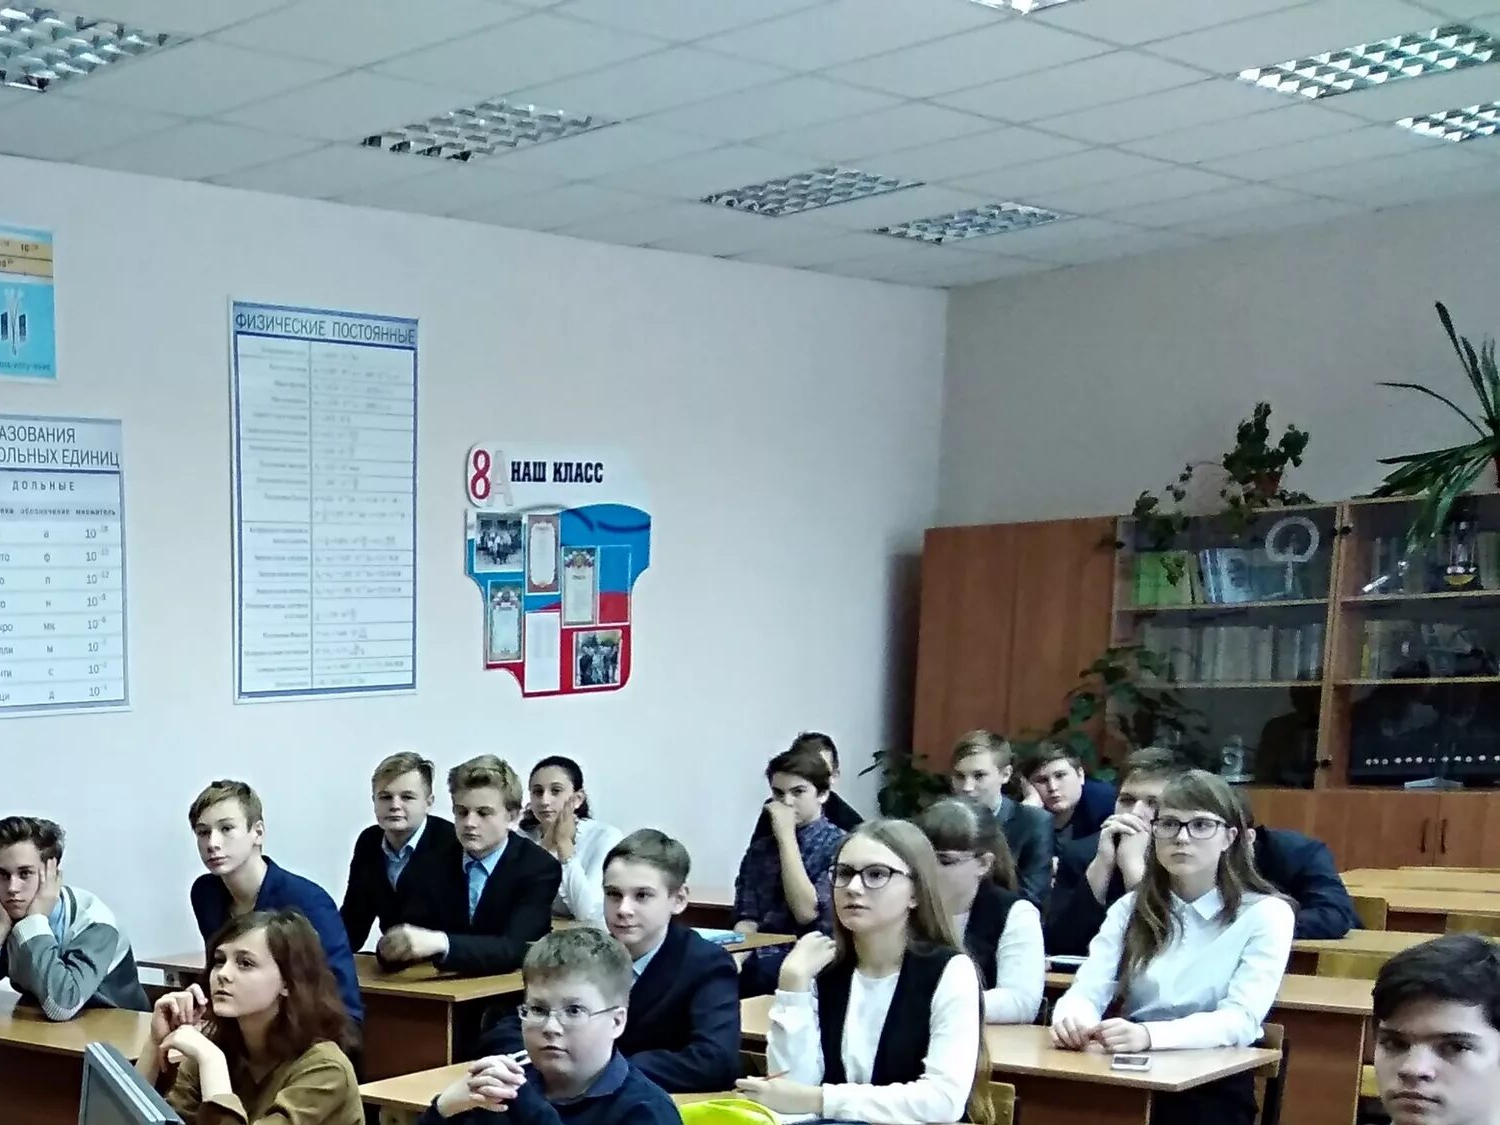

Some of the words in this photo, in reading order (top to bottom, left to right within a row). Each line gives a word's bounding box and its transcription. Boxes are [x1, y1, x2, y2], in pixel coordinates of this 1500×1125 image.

[235, 312, 326, 337] ФИЗИЧЕСКИЕ
[333, 321, 416, 345] ПОСТОЯННЫЕ
[61, 450, 119, 467] ЕДИНИЦ
[511, 461, 547, 483] НАШ
[553, 462, 604, 484] КЛАСС
[12, 480, 75, 492] ДОЛЬНЫЕ
